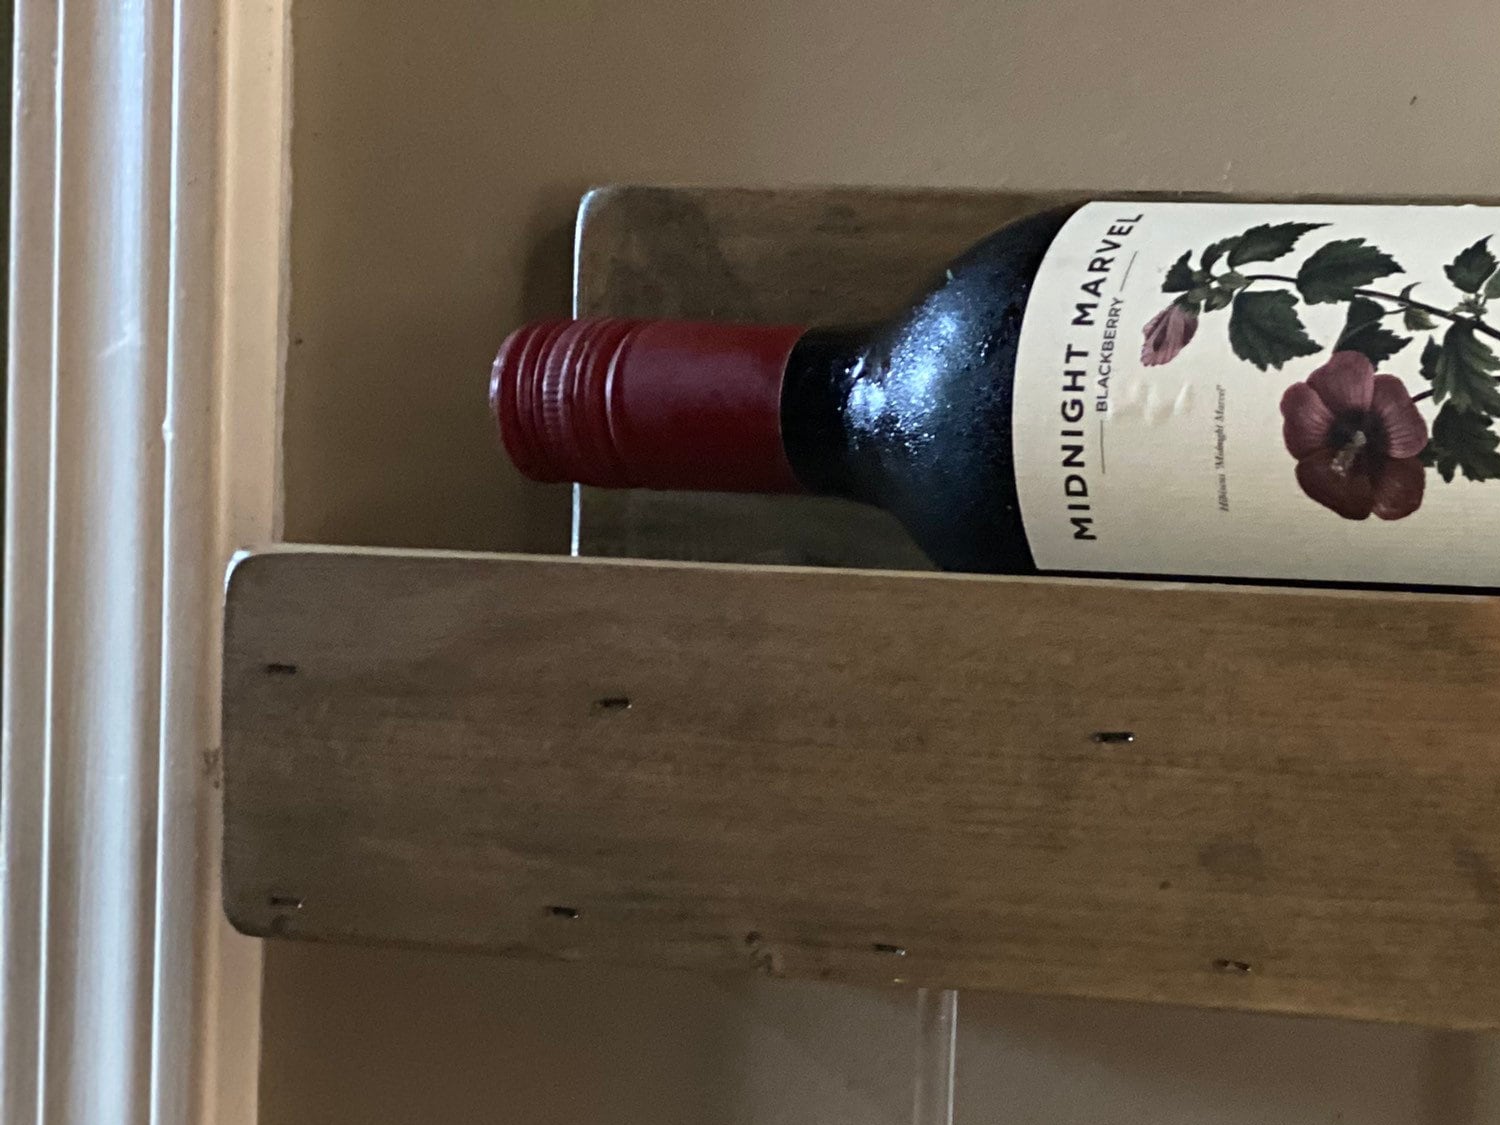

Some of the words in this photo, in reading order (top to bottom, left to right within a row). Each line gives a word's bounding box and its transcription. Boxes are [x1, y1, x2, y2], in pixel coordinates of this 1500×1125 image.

[1071, 214, 1144, 327] MARVEL
[1095, 297, 1125, 413] BLACKBERRY
[1061, 344, 1097, 541] MIDNIGHT
